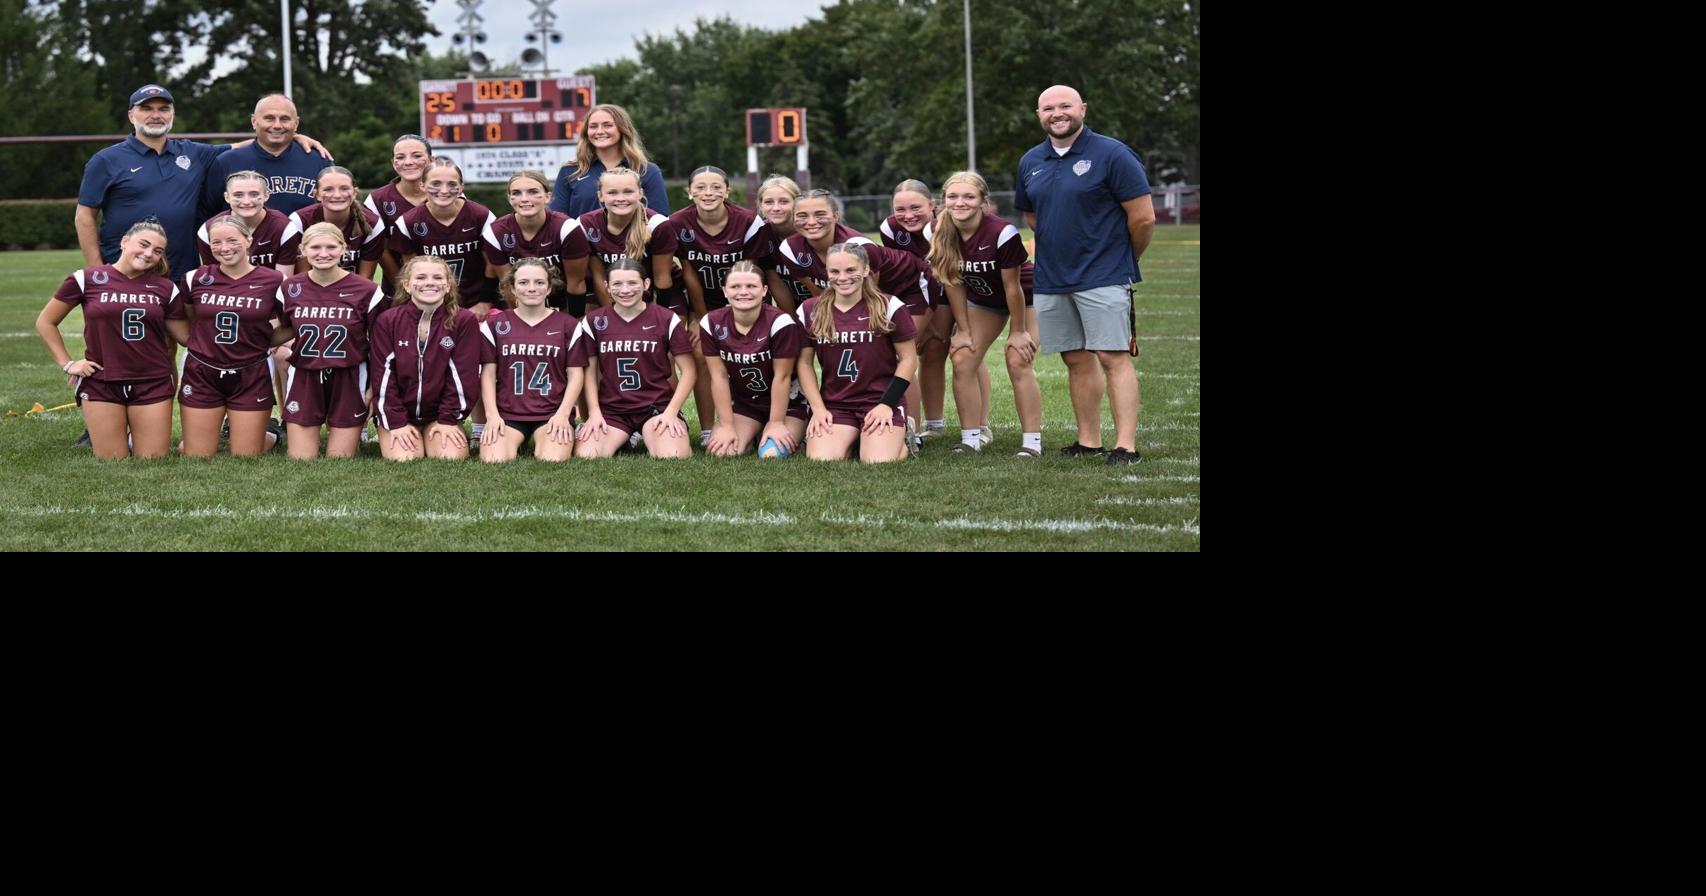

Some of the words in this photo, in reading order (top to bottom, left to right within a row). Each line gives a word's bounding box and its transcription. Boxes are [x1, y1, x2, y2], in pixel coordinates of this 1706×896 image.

[426, 92, 456, 113] 25
[576, 88, 590, 107] 7
[436, 114, 468, 125] DOWN
[471, 113, 485, 124] TO
[512, 112, 534, 124] BALL
[535, 111, 550, 123] ON
[486, 124, 501, 142] 0
[778, 110, 800, 143] 0
[423, 240, 479, 256] GARRETT
[688, 250, 743, 263] GARRETT
[957, 260, 996, 272] RRETT
[100, 292, 161, 305] GARRETT
[200, 293, 262, 309] GARRETT
[294, 306, 354, 319] GARRETT
[122, 308, 145, 341] 6
[214, 311, 239, 344] 9
[299, 323, 348, 358] 22
[600, 340, 657, 353] GARRETT
[502, 343, 560, 357] GARRETT
[719, 350, 771, 364] GARRETT
[837, 348, 859, 383] 4
[509, 361, 552, 396] 14
[616, 357, 641, 392] 5
[739, 367, 768, 391] 3
